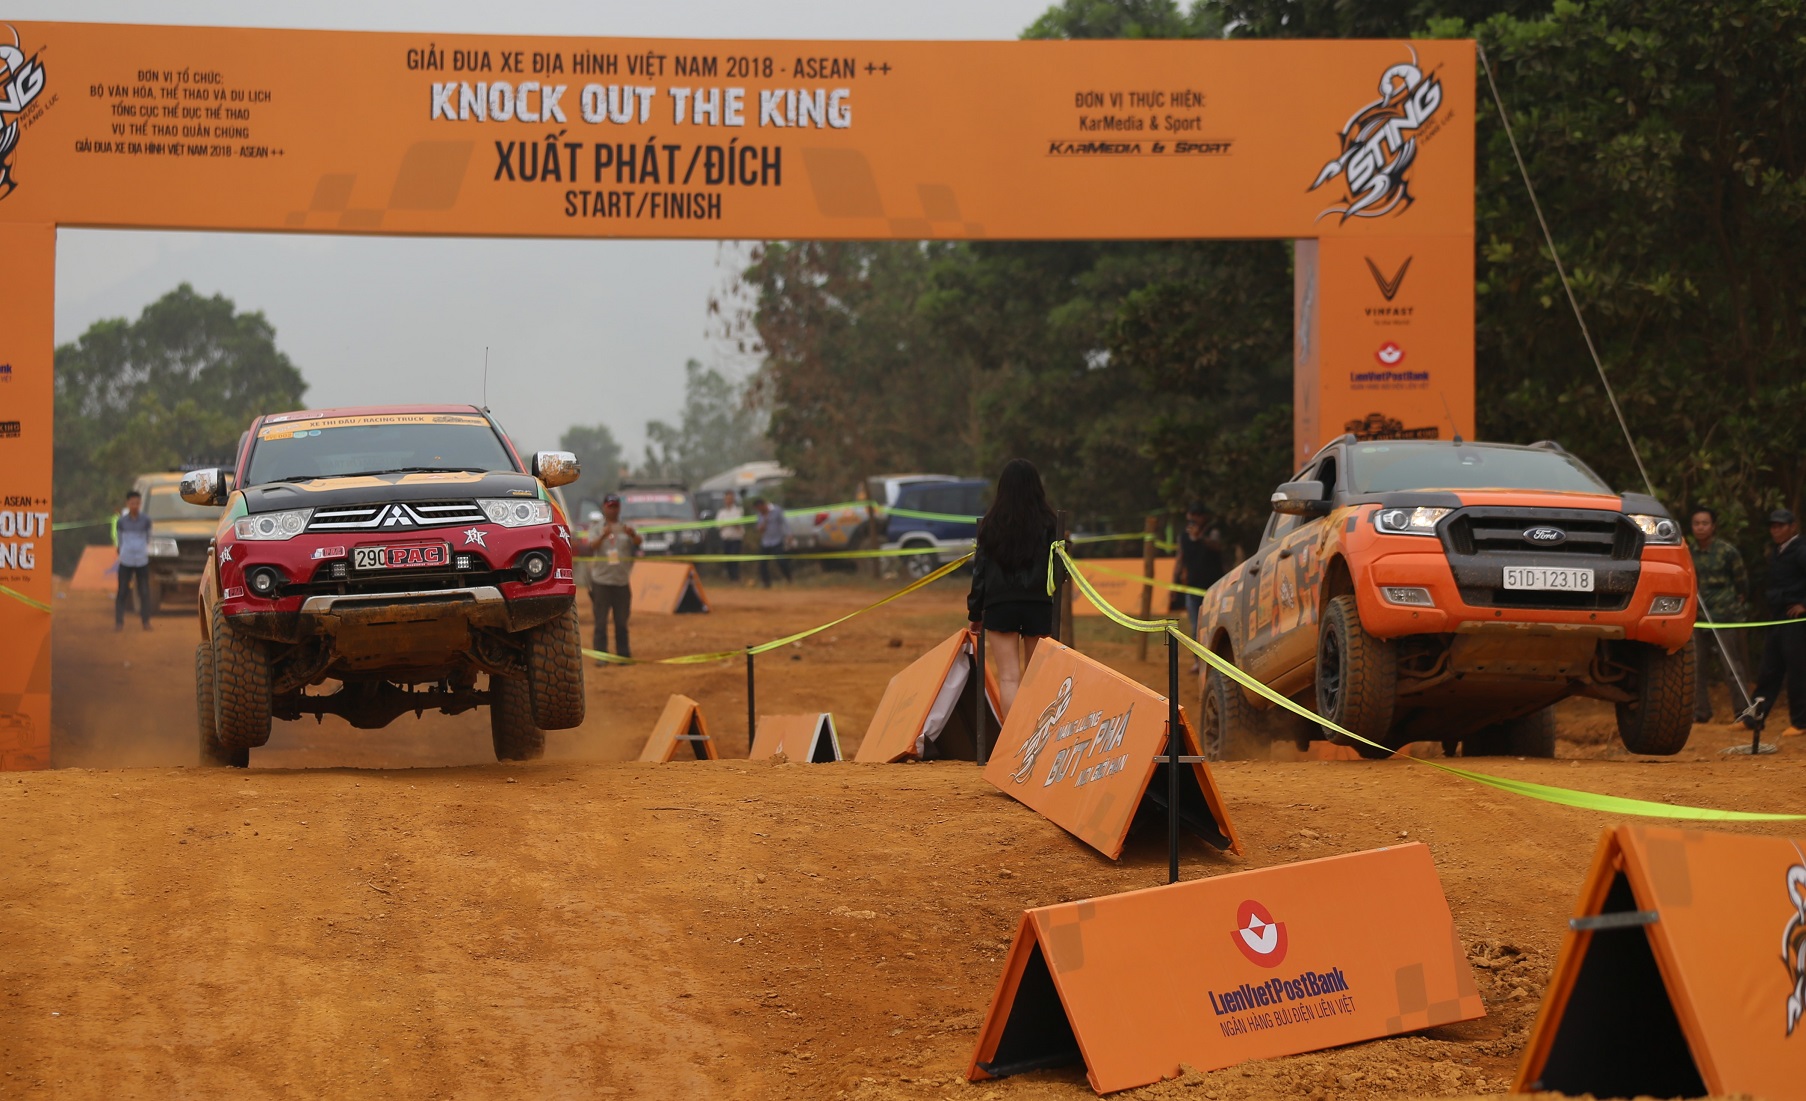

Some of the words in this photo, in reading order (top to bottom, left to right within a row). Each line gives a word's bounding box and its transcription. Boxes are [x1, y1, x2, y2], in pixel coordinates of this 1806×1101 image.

[407, 43, 445, 71] GIẢI
[453, 51, 492, 73] ĐUA
[501, 52, 524, 73] XE
[532, 52, 564, 78] ĐỊA
[572, 49, 618, 75] HÌNH
[627, 51, 667, 80] VIỆT
[675, 56, 718, 78] NAM
[726, 57, 774, 78] 2018
[793, 58, 856, 79] ASEAN
[863, 61, 892, 77] ++
[163, 70, 173, 84] VỊ
[183, 87, 209, 101] THAO
[231, 90, 245, 102] DU
[249, 90, 271, 104] LỊCH
[431, 80, 568, 123] KNOCK
[580, 83, 656, 125] OUT
[668, 86, 746, 126] THE
[759, 87, 852, 129] KING
[1075, 90, 1104, 108] ĐƠN
[1109, 91, 1123, 111] VỊ
[225, 108, 250, 121] THAO
[151, 124, 179, 137] THAO
[1079, 115, 1144, 132] KarMedia
[1149, 115, 1159, 131] &
[1164, 115, 1202, 135] Sport
[1347, 77, 1443, 194] STING
[94, 142, 112, 154] ĐUA
[114, 142, 126, 155] XE
[187, 144, 208, 157] NAM
[210, 145, 232, 157] 2018
[240, 146, 269, 158] ASEAN
[493, 129, 584, 183] XUẤT
[594, 135, 782, 187] PHÁT/ĐÍCH
[565, 190, 722, 220] START/FINISH
[1365, 307, 1414, 316] VINFAST
[4, 496, 32, 507] ASEAN
[0, 510, 49, 538] OUT
[1533, 529, 1558, 540] Ford
[0, 542, 35, 570] NG
[393, 548, 439, 563] PAC
[1508, 570, 1589, 588] 51D-123.18
[1208, 967, 1349, 1015] LienVietPostBank
[1220, 1016, 1248, 1037] NGÂN
[1248, 1012, 1274, 1031] HÀNG
[1292, 1003, 1315, 1023] ĐIỆN
[1315, 998, 1336, 1019] LIÊN
[1337, 994, 1356, 1015] VIỆT
